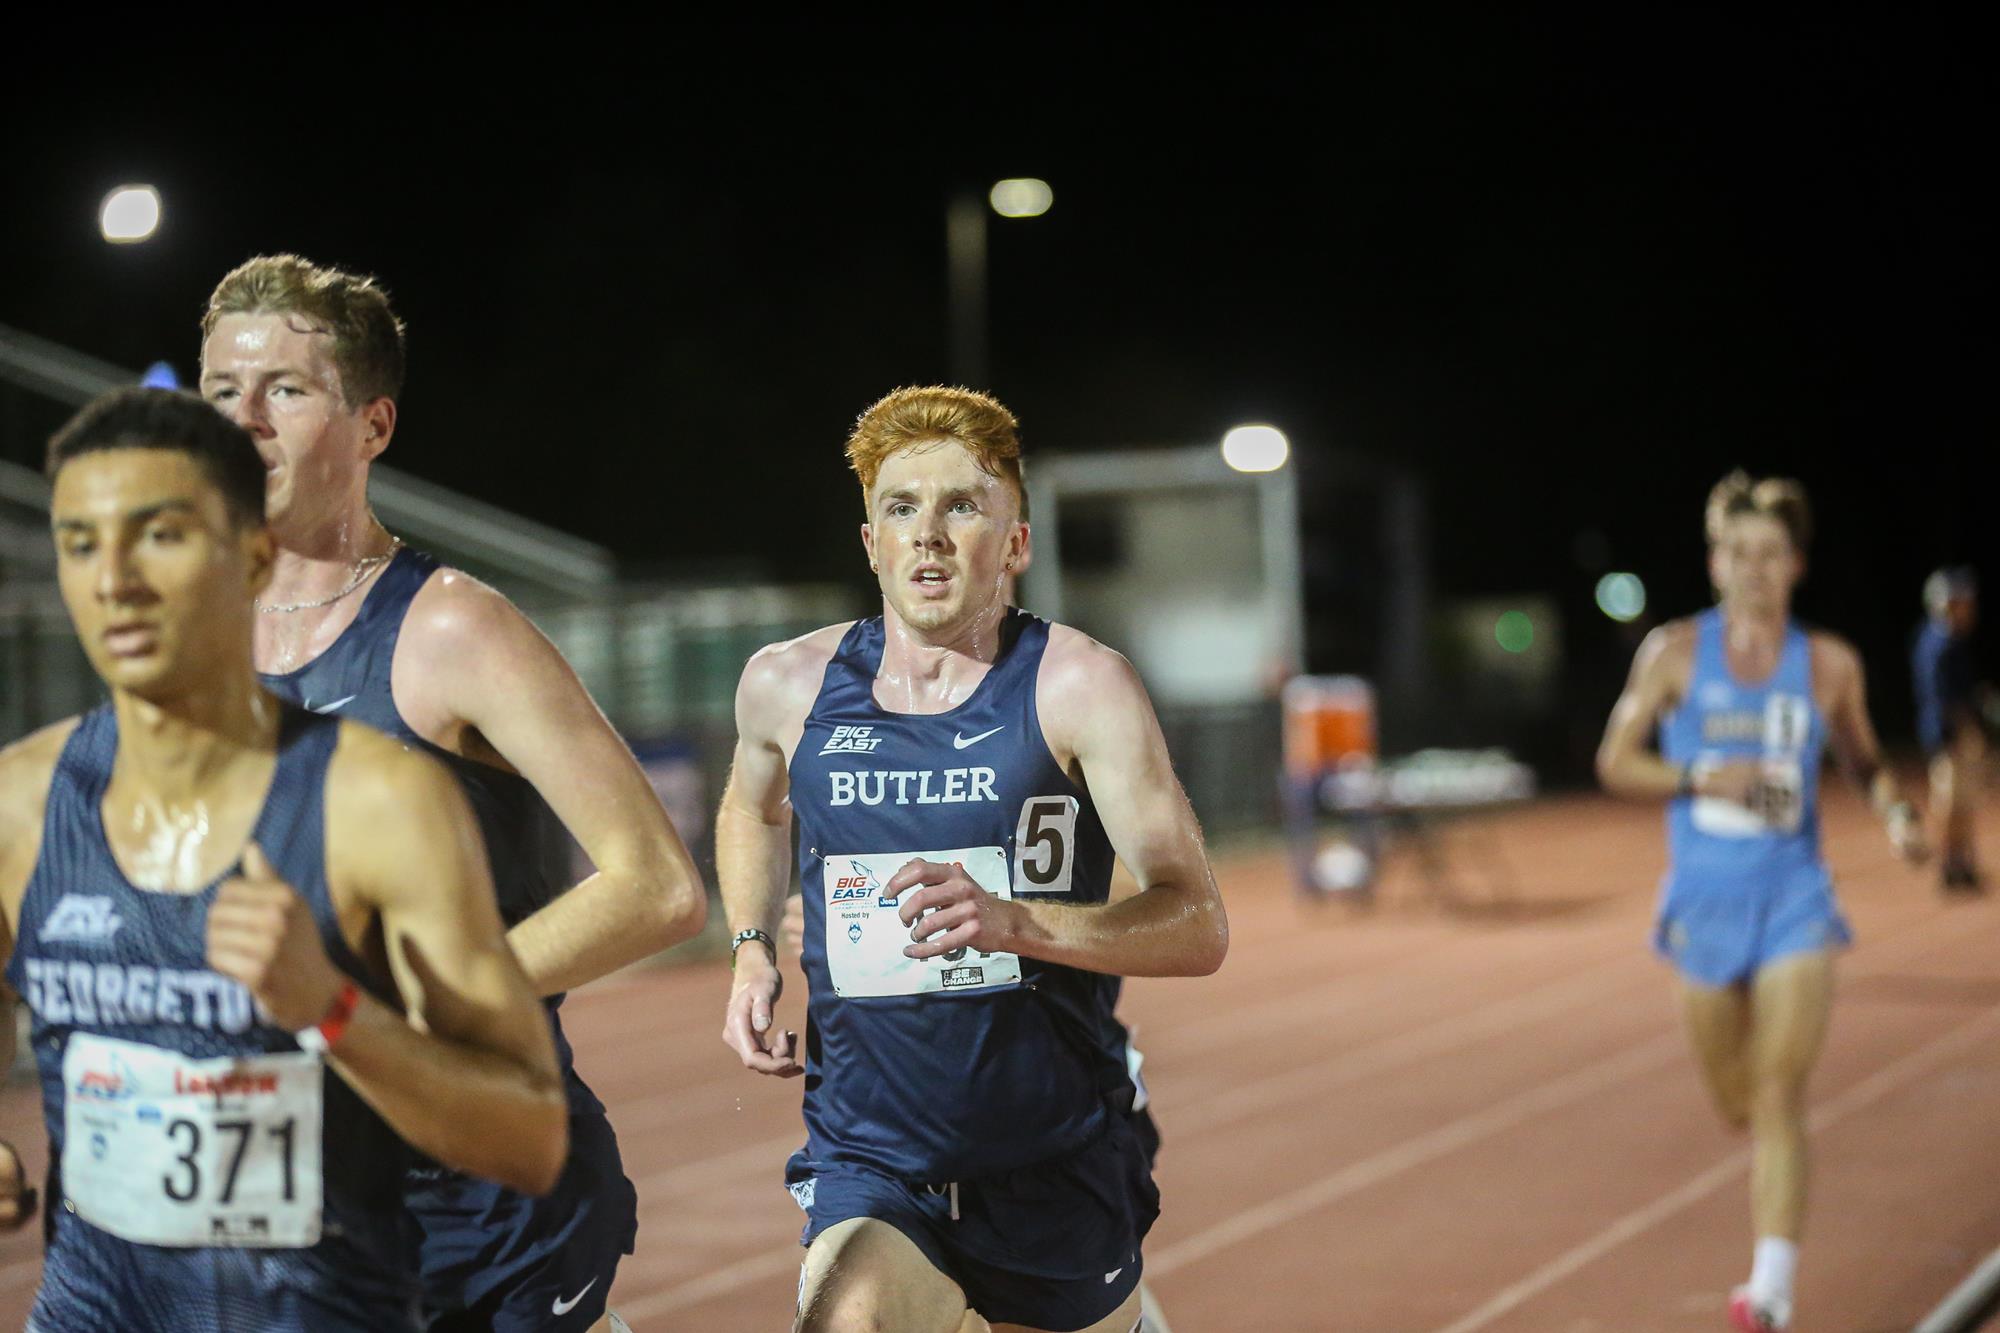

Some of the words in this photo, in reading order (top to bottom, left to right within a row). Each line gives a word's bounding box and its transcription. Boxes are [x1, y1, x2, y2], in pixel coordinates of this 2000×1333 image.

[832, 725, 874, 738] BIG
[823, 738, 882, 750] EAST
[829, 766, 999, 806] BUTLER
[1022, 802, 1066, 885] 5
[837, 876, 867, 888] BIG
[832, 888, 876, 899] EAST
[880, 898, 897, 906] Jeep
[951, 968, 970, 979] BE
[943, 975, 982, 986] CHANGE
[25, 957, 268, 1035] EORGETO
[163, 1115, 297, 1205] 371
